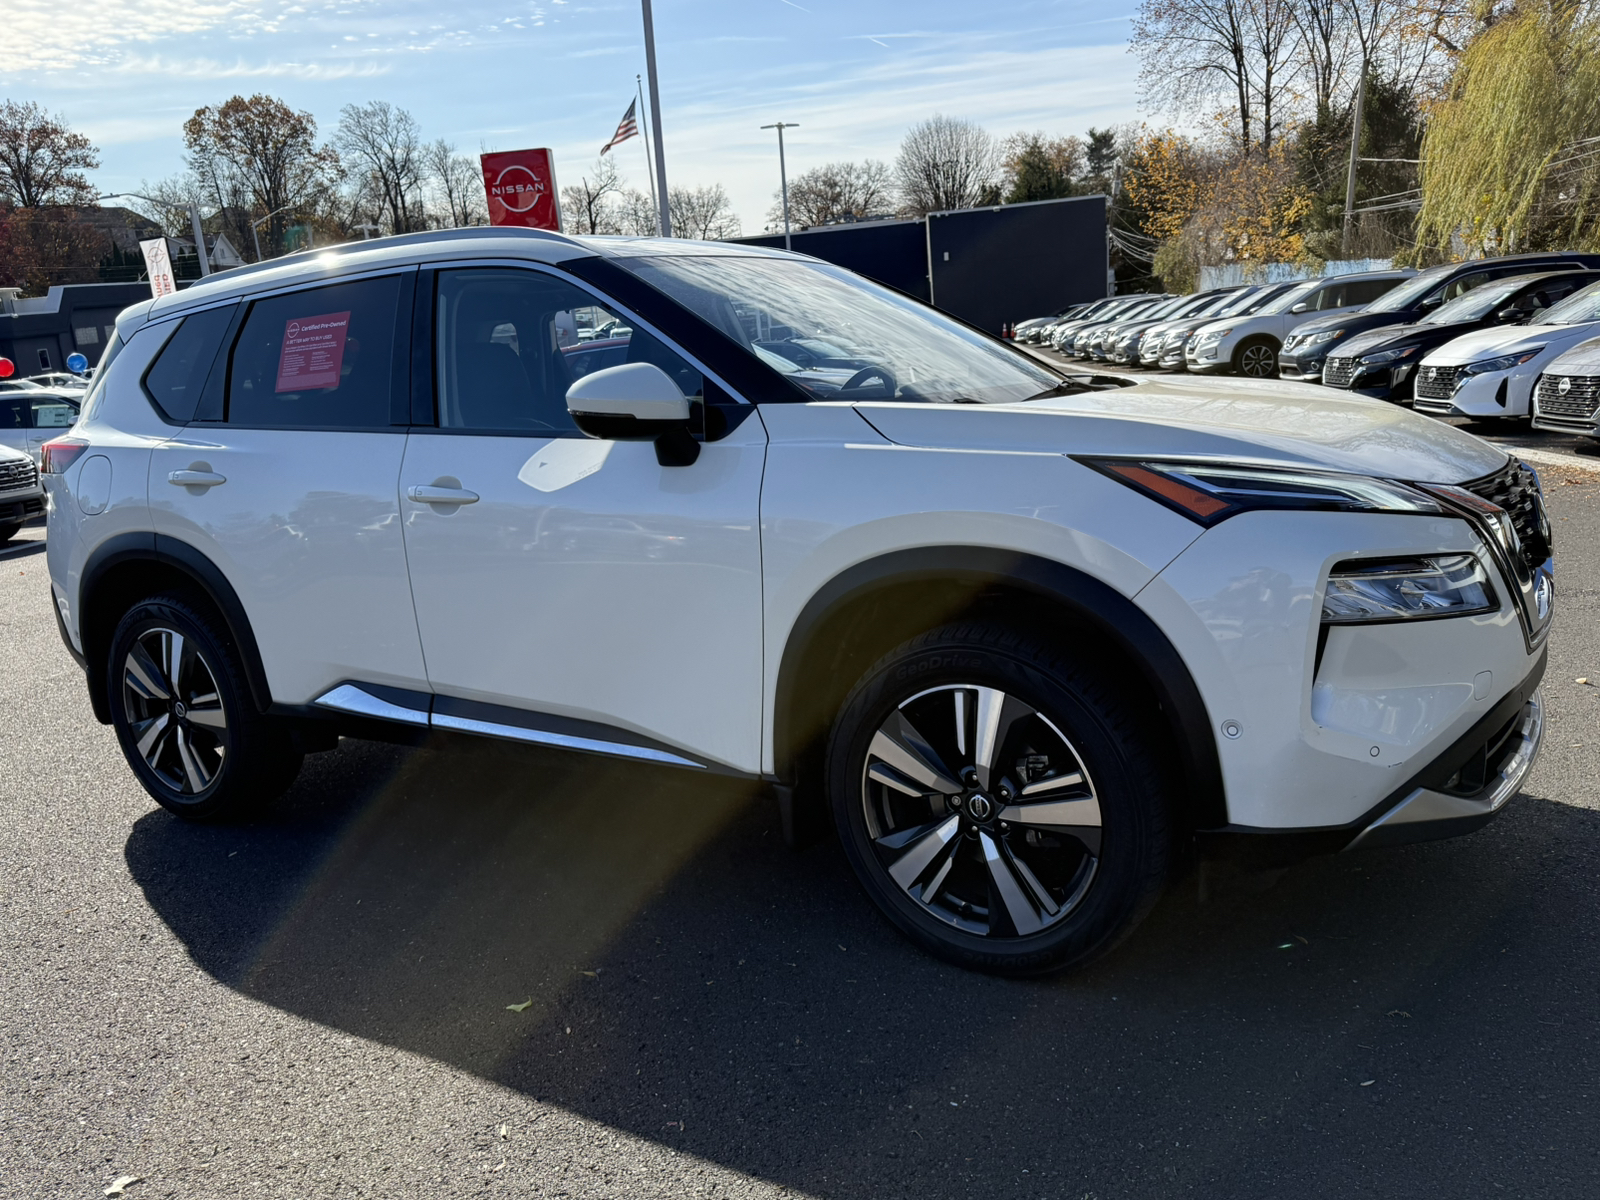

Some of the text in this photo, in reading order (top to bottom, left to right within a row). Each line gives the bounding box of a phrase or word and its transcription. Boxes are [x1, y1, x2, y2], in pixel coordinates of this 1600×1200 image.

[491, 182, 544, 195] NISSAN
[321, 320, 346, 328] Pre-Owned
[896, 654, 982, 680] GeoDrive
